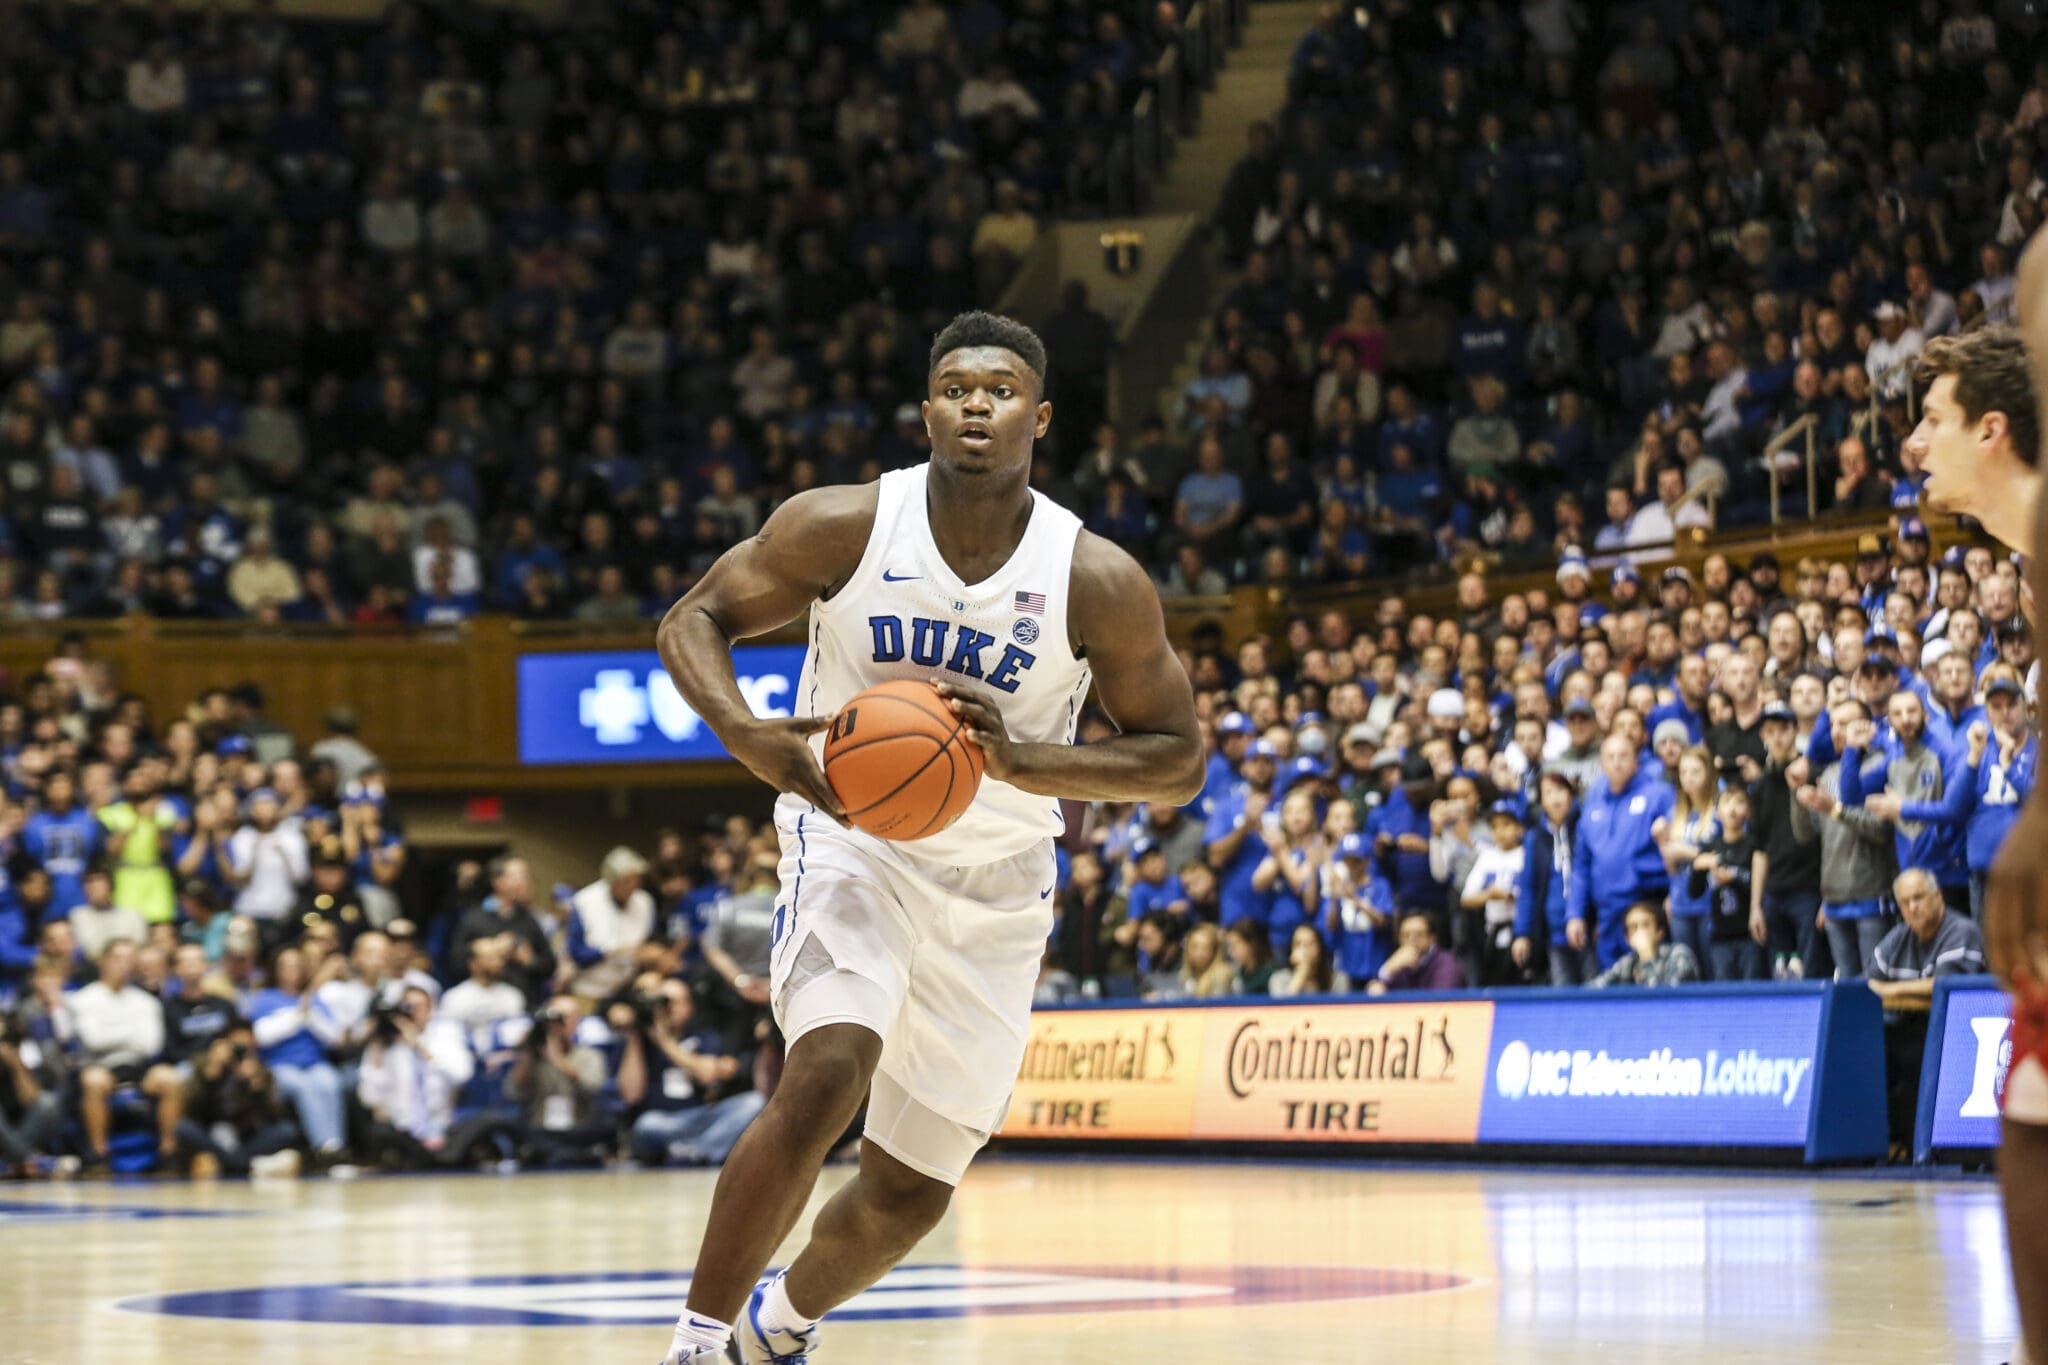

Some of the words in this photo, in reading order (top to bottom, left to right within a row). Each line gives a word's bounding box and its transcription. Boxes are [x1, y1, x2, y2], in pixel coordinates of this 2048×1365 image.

[869, 614, 1036, 694] DUKE
[1226, 1017, 1424, 1099] Continental
[1528, 1050, 1571, 1096] NC
[1569, 1047, 1702, 1096] Education
[1703, 1049, 1806, 1106] Lottery
[1028, 1098, 1111, 1127] TIRE
[1281, 1099, 1383, 1131] TIRE
